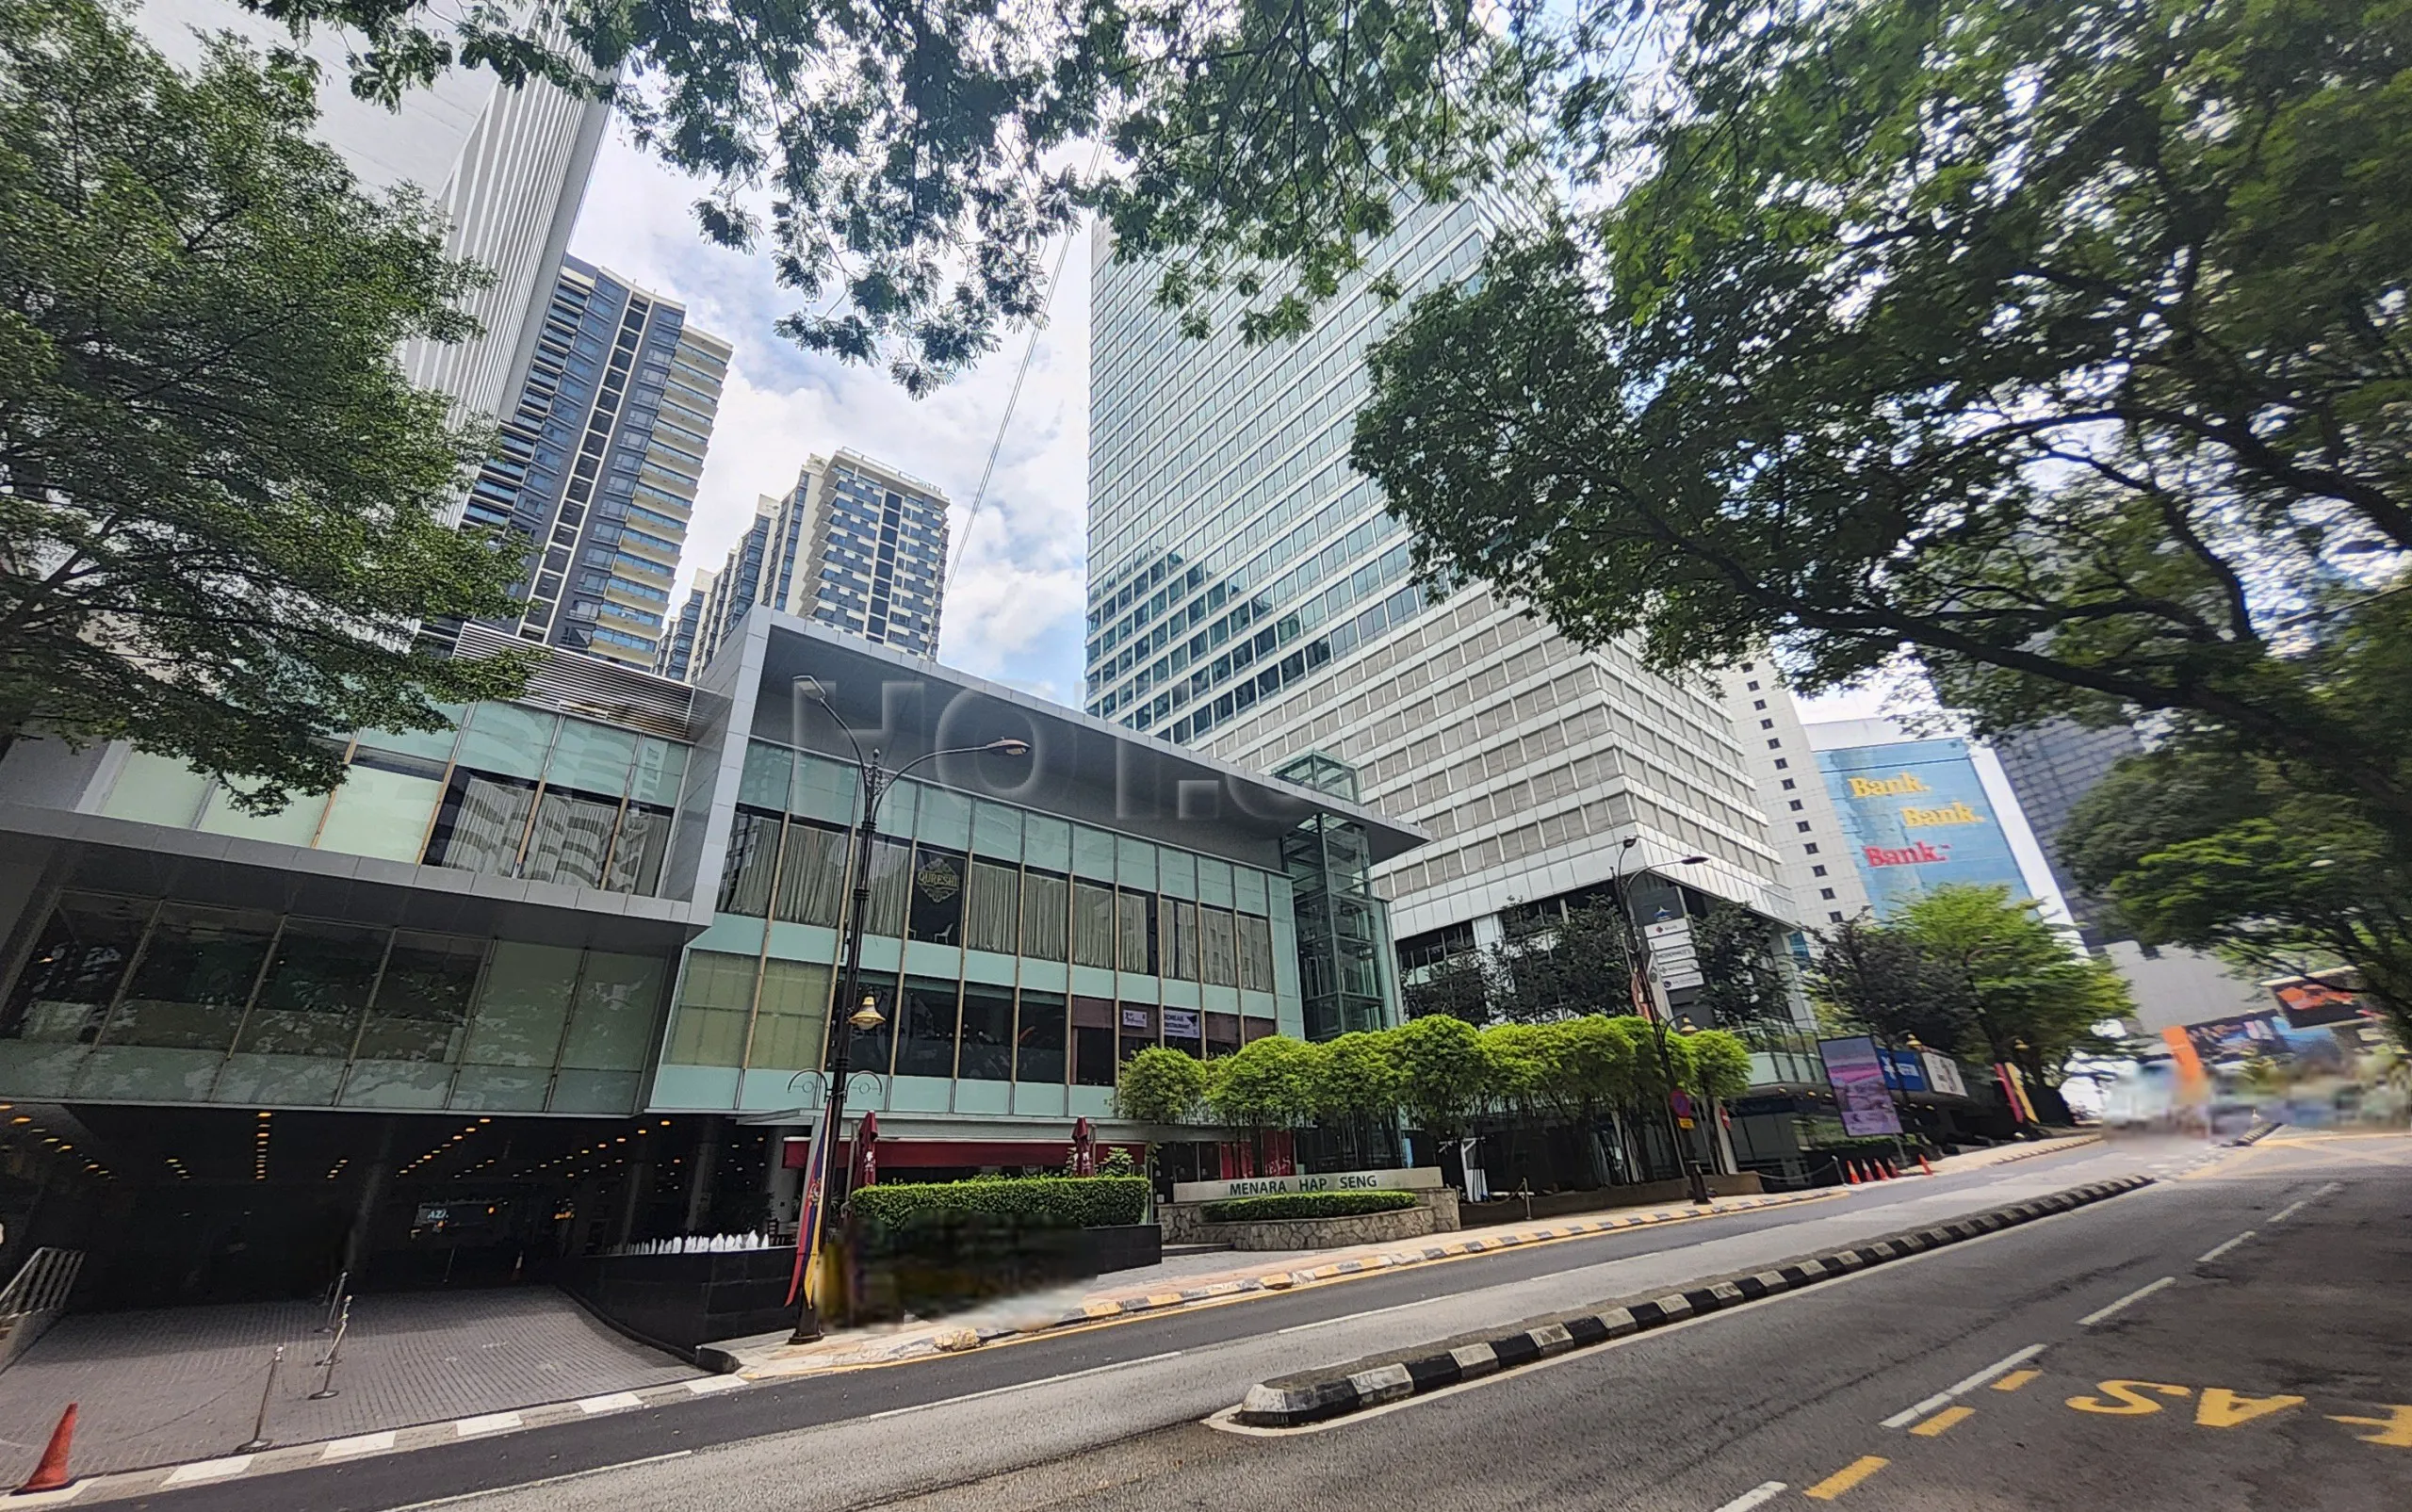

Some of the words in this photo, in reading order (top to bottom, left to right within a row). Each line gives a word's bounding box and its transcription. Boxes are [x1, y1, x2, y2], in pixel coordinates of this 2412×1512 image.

[918, 870, 959, 886] QURESHI
[1230, 1181, 1287, 1195] MENARA
[1299, 1179, 1327, 1192] HAP
[1340, 1176, 1377, 1189] SENG
